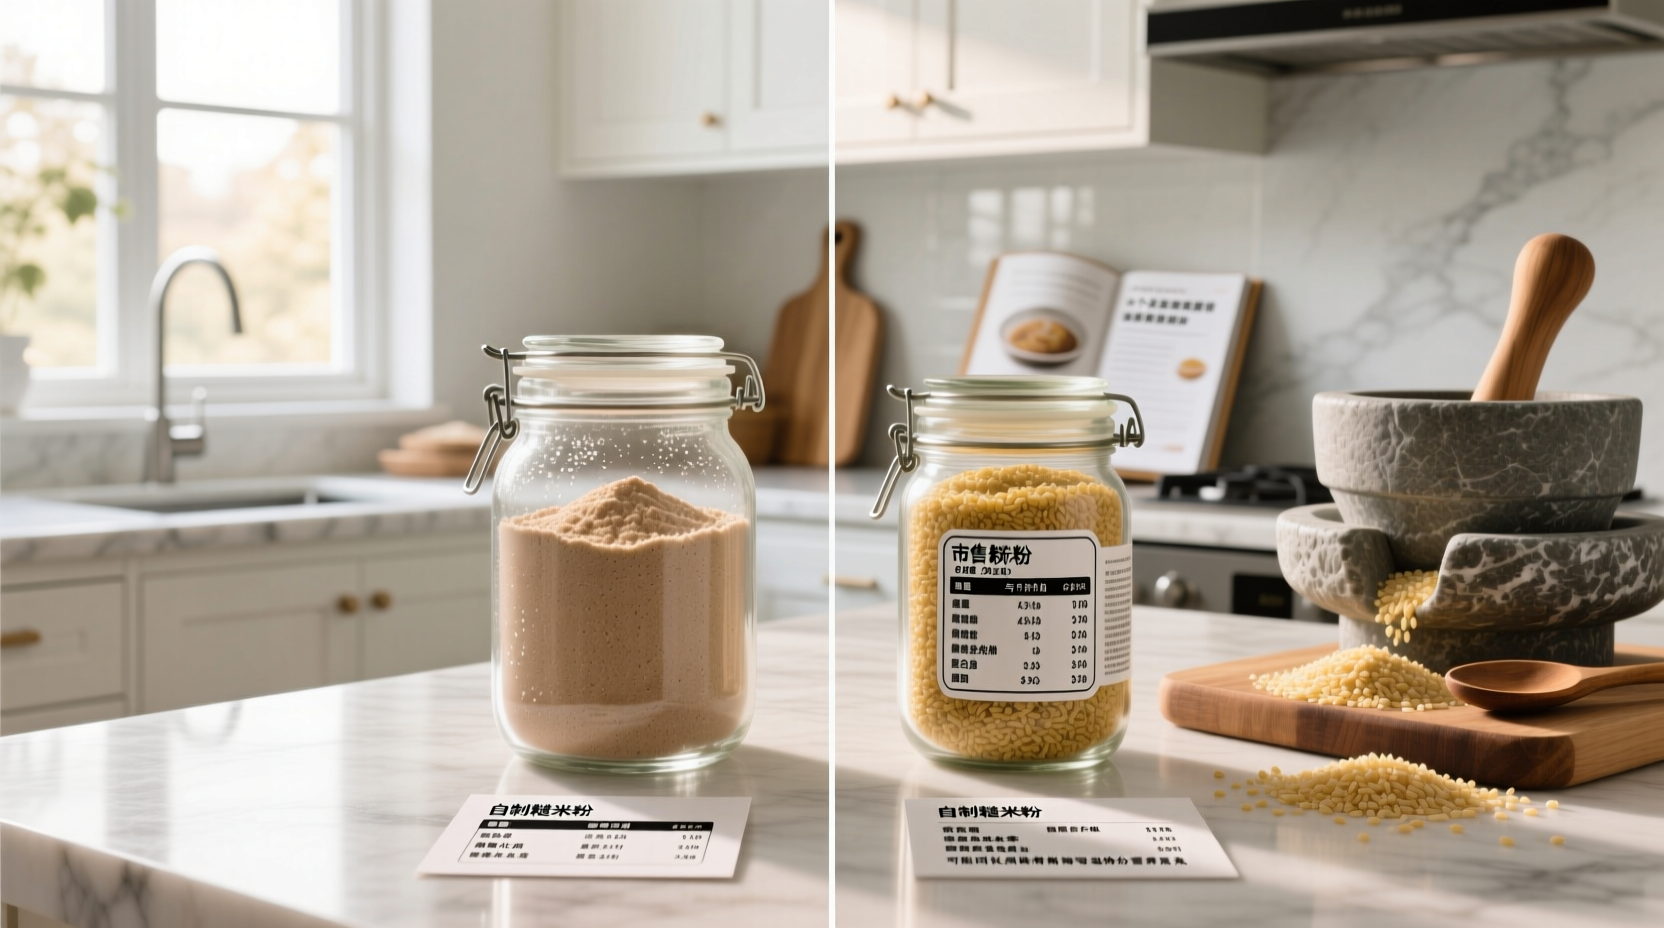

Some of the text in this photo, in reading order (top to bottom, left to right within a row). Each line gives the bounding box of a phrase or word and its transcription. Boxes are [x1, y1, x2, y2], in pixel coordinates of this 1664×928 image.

[489, 803, 594, 817] 自制糙米粉
[939, 805, 1042, 819] 自制糙米粉
